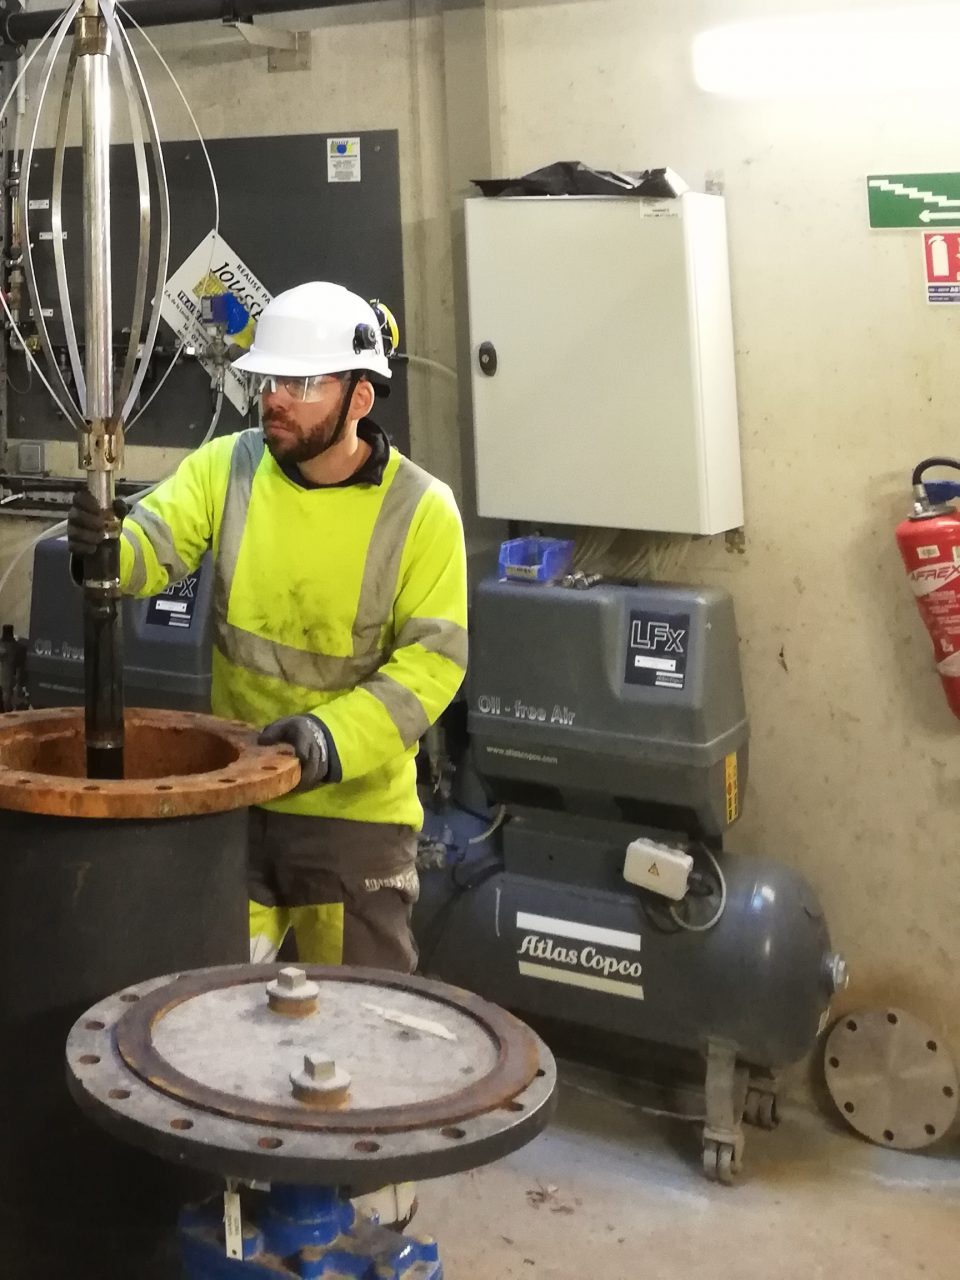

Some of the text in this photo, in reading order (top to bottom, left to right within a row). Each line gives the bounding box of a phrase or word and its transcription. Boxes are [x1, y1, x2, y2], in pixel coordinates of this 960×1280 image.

[260, 292, 271, 304] PA
[478, 695, 501, 715] Oil
[515, 699, 547, 721] free
[550, 704, 576, 726] Air
[516, 934, 642, 977] Atlas Copco
